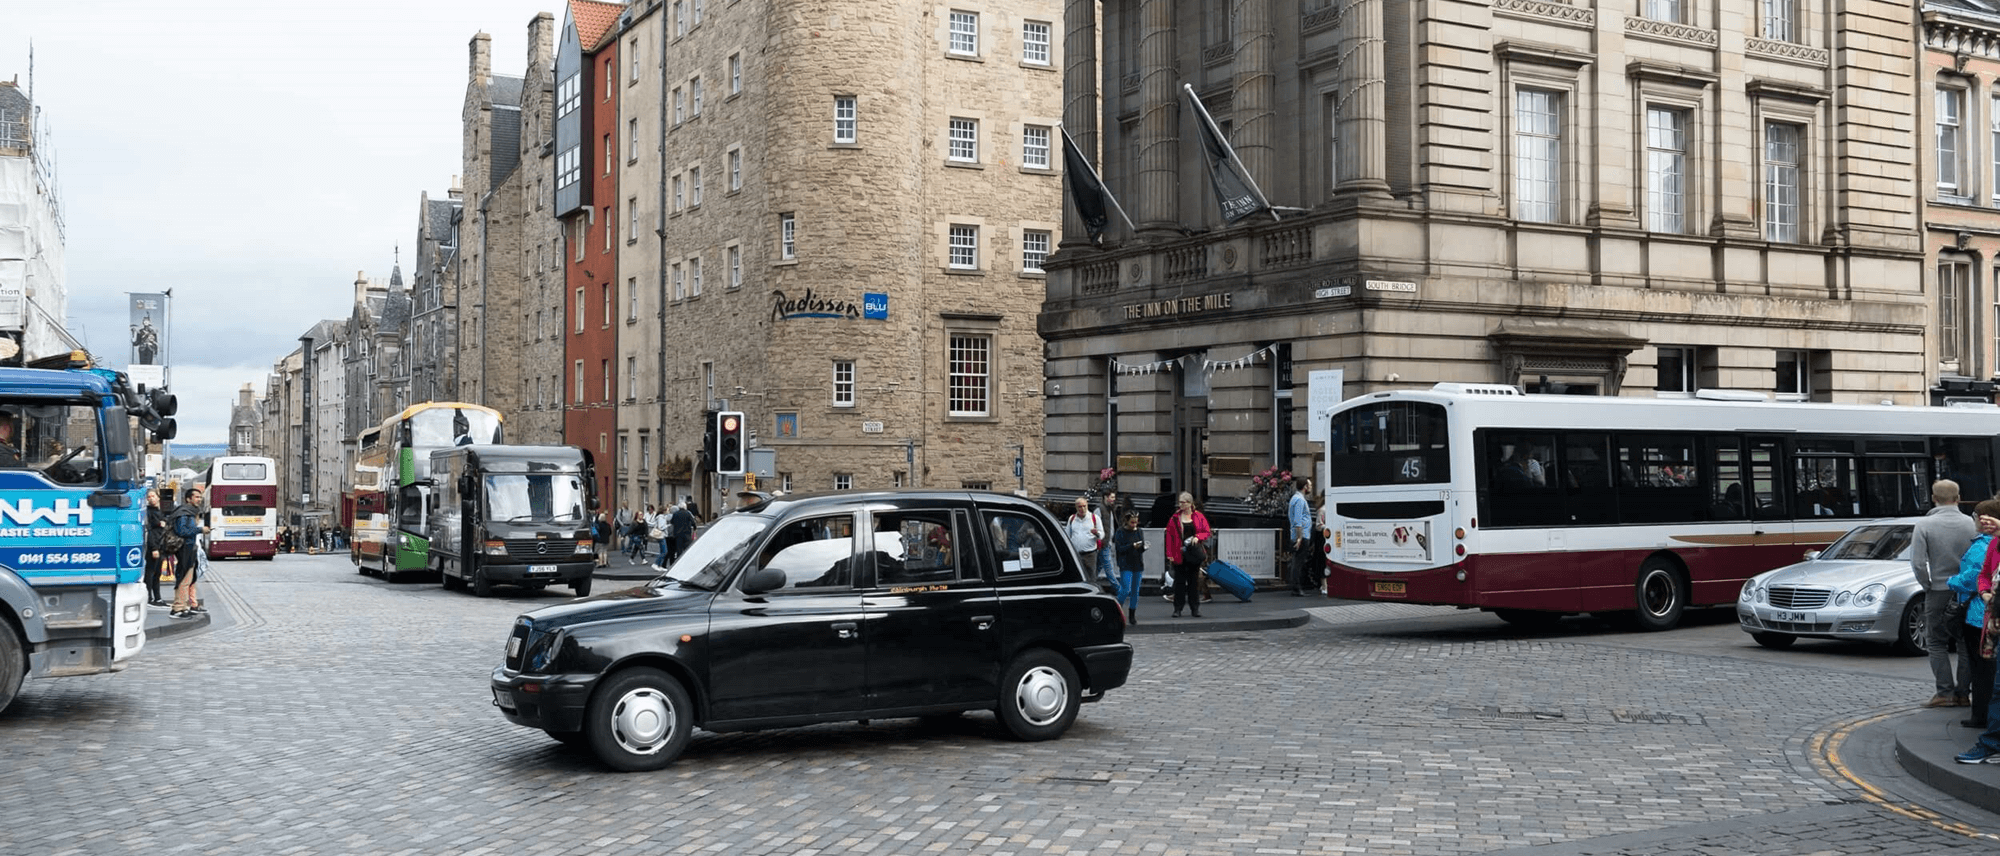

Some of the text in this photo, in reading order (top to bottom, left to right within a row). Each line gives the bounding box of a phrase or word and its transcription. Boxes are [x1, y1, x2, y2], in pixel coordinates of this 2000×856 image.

[1367, 281, 1414, 291] SOUTH BRIDGE
[1316, 287, 1350, 298] HIGH STREET
[771, 287, 860, 321] Radisson
[1123, 292, 1231, 319] THE INN ON THE MILE
[1401, 459, 1420, 478] 45
[1439, 490, 1450, 500] 173
[0, 499, 93, 525] NWH
[0, 527, 93, 538] ASTE SERVICES
[18, 552, 101, 564] 0141 554 5882
[1777, 611, 1787, 620] H3
